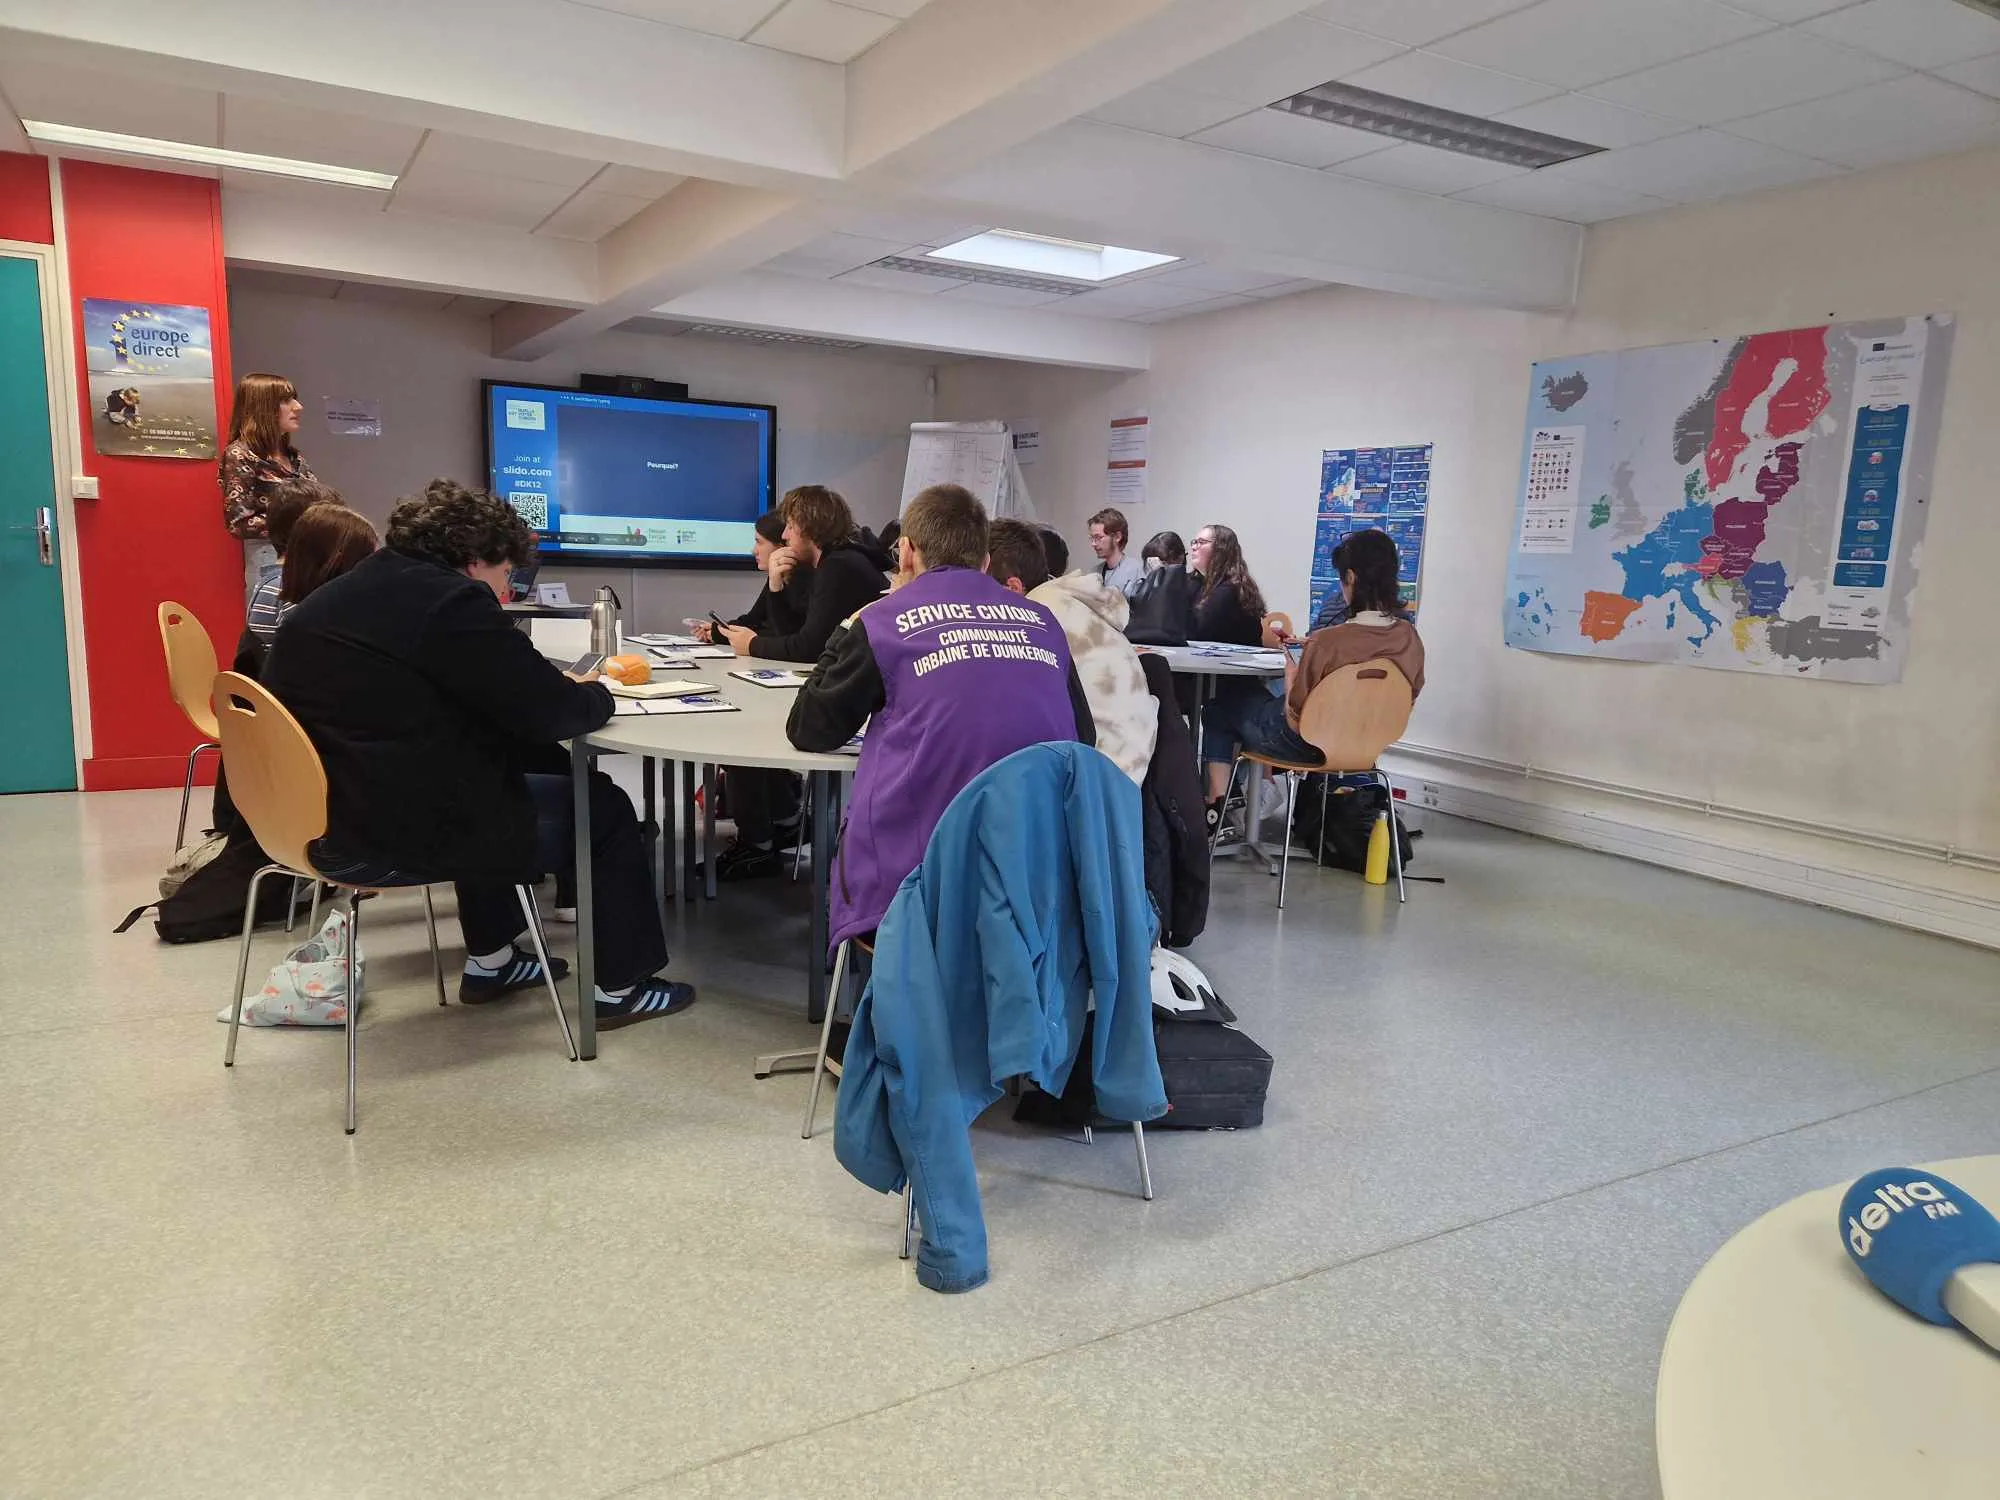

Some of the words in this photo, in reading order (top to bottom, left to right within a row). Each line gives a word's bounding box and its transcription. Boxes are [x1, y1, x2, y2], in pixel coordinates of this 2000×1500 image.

[131, 328, 190, 346] europe
[132, 342, 180, 358] direct
[514, 455, 531, 463] Join
[503, 465, 552, 477] slido.com
[514, 480, 542, 488] #DK12
[896, 603, 976, 633] SERVICE
[976, 604, 1046, 626] CIVIQUE
[938, 628, 1031, 646] COMMUNAUTÉ
[913, 643, 971, 677] URBAINE
[973, 645, 991, 658] DE
[993, 644, 1060, 669] DUNKERQUE
[1848, 1181, 1947, 1257] delta
[1922, 1201, 1962, 1221] FM
